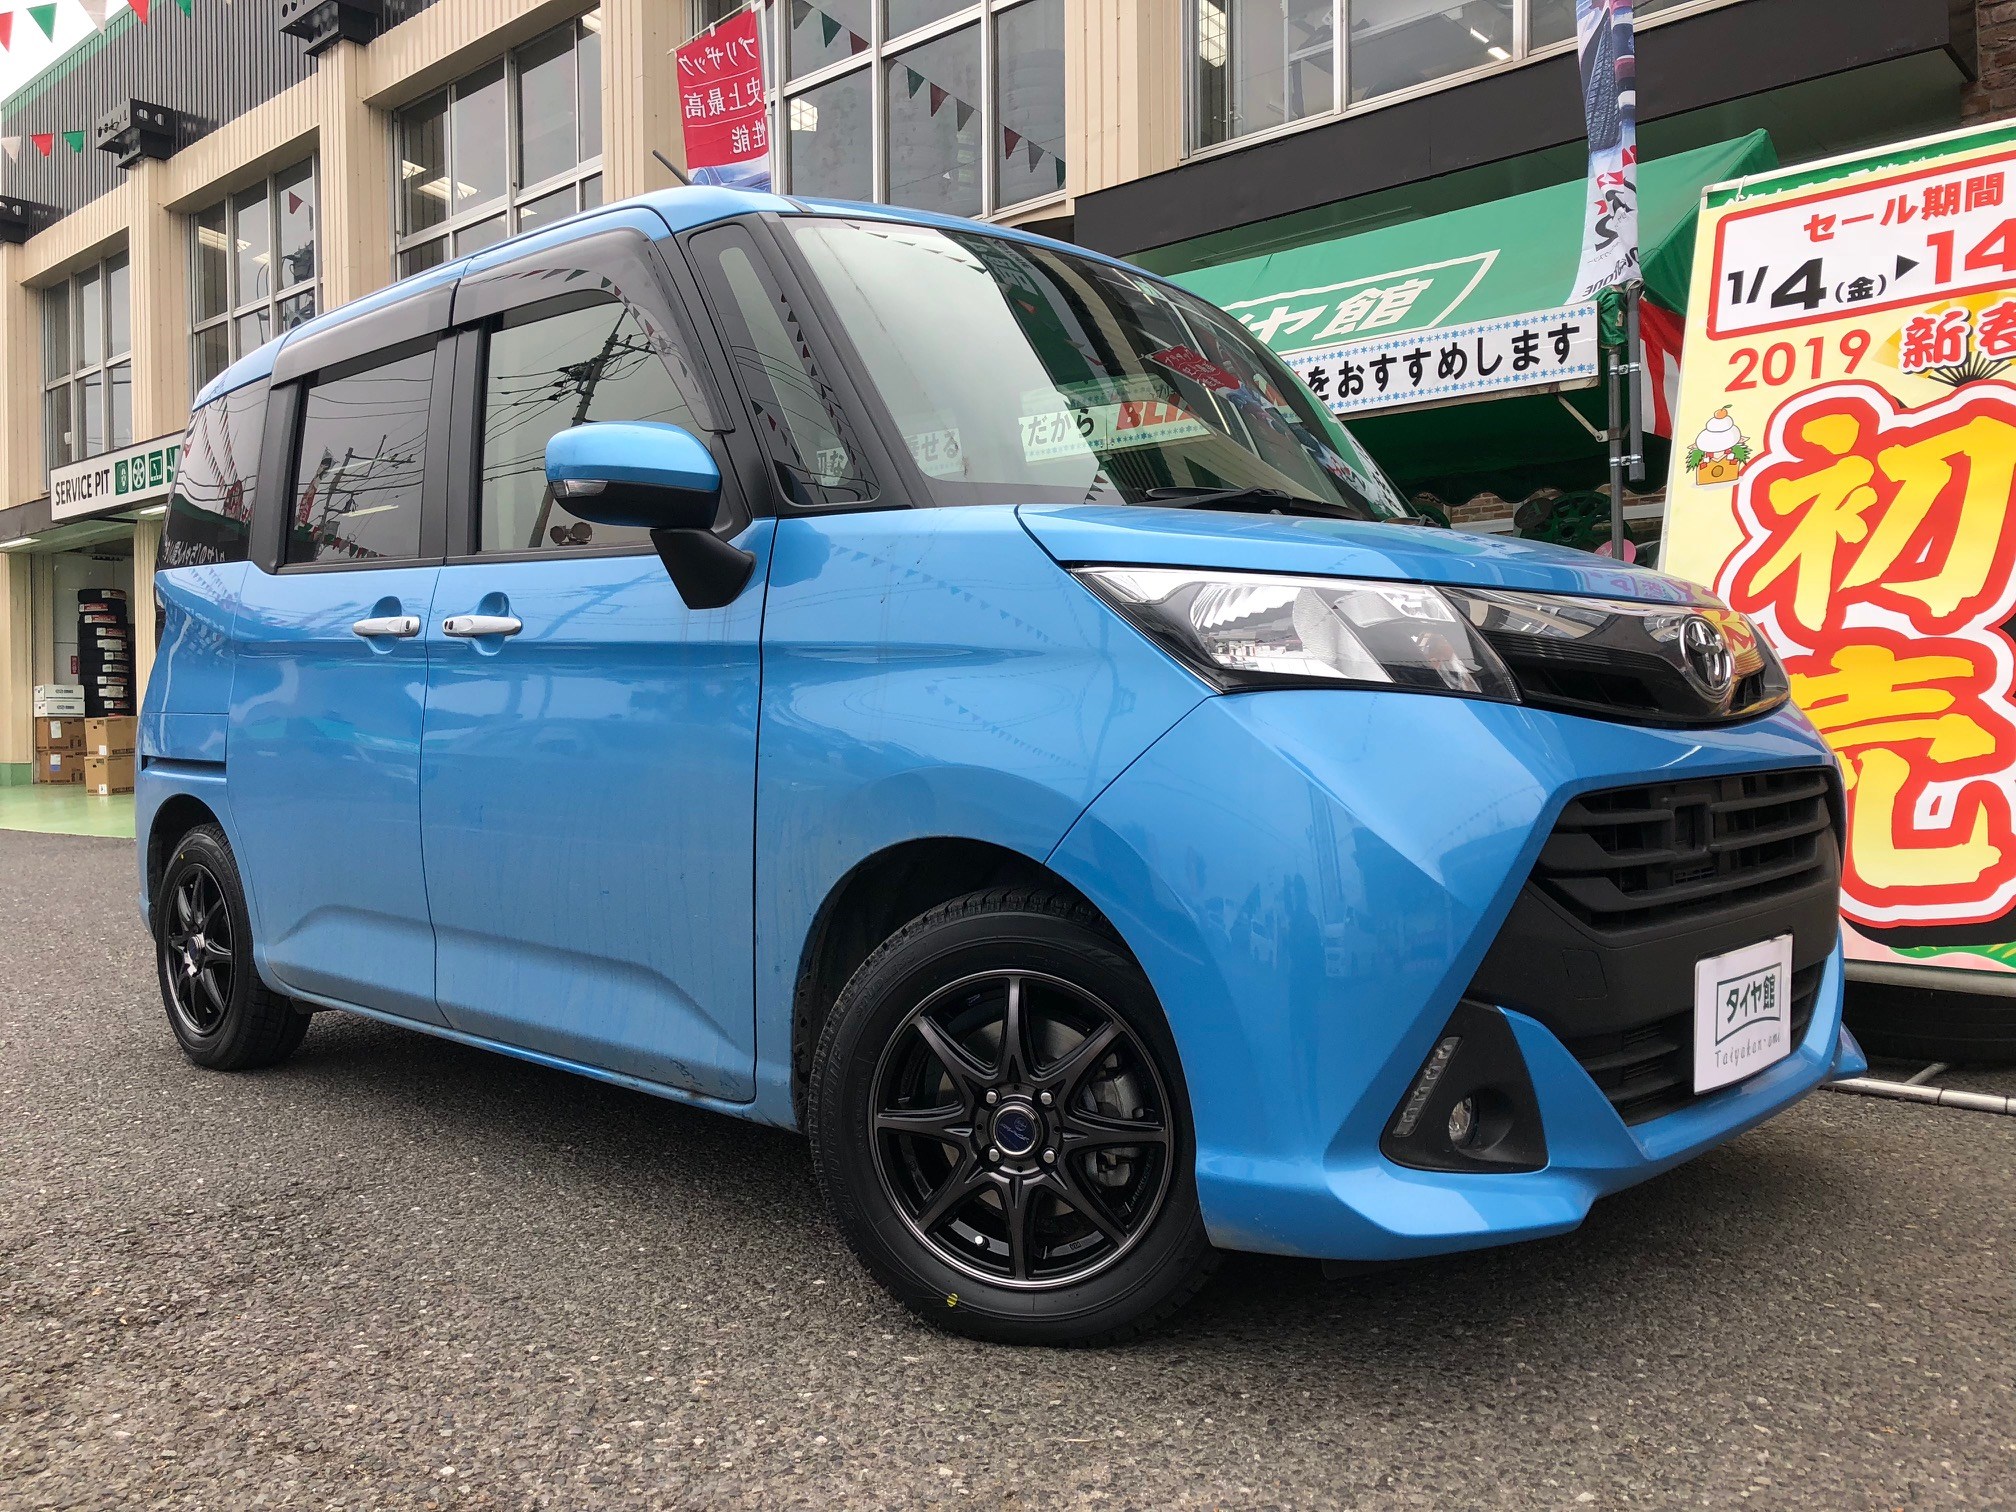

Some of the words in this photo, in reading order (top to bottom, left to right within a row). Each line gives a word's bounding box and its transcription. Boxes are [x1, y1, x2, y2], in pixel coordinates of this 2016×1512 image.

[1803, 171, 2005, 243] セール期間
[1307, 322, 1582, 402] をおすすめします
[1725, 328, 1872, 393] 2019
[55, 474, 92, 506] SERVICE
[95, 469, 110, 497] PIT
[1726, 974, 1776, 1024] タイヤ館
